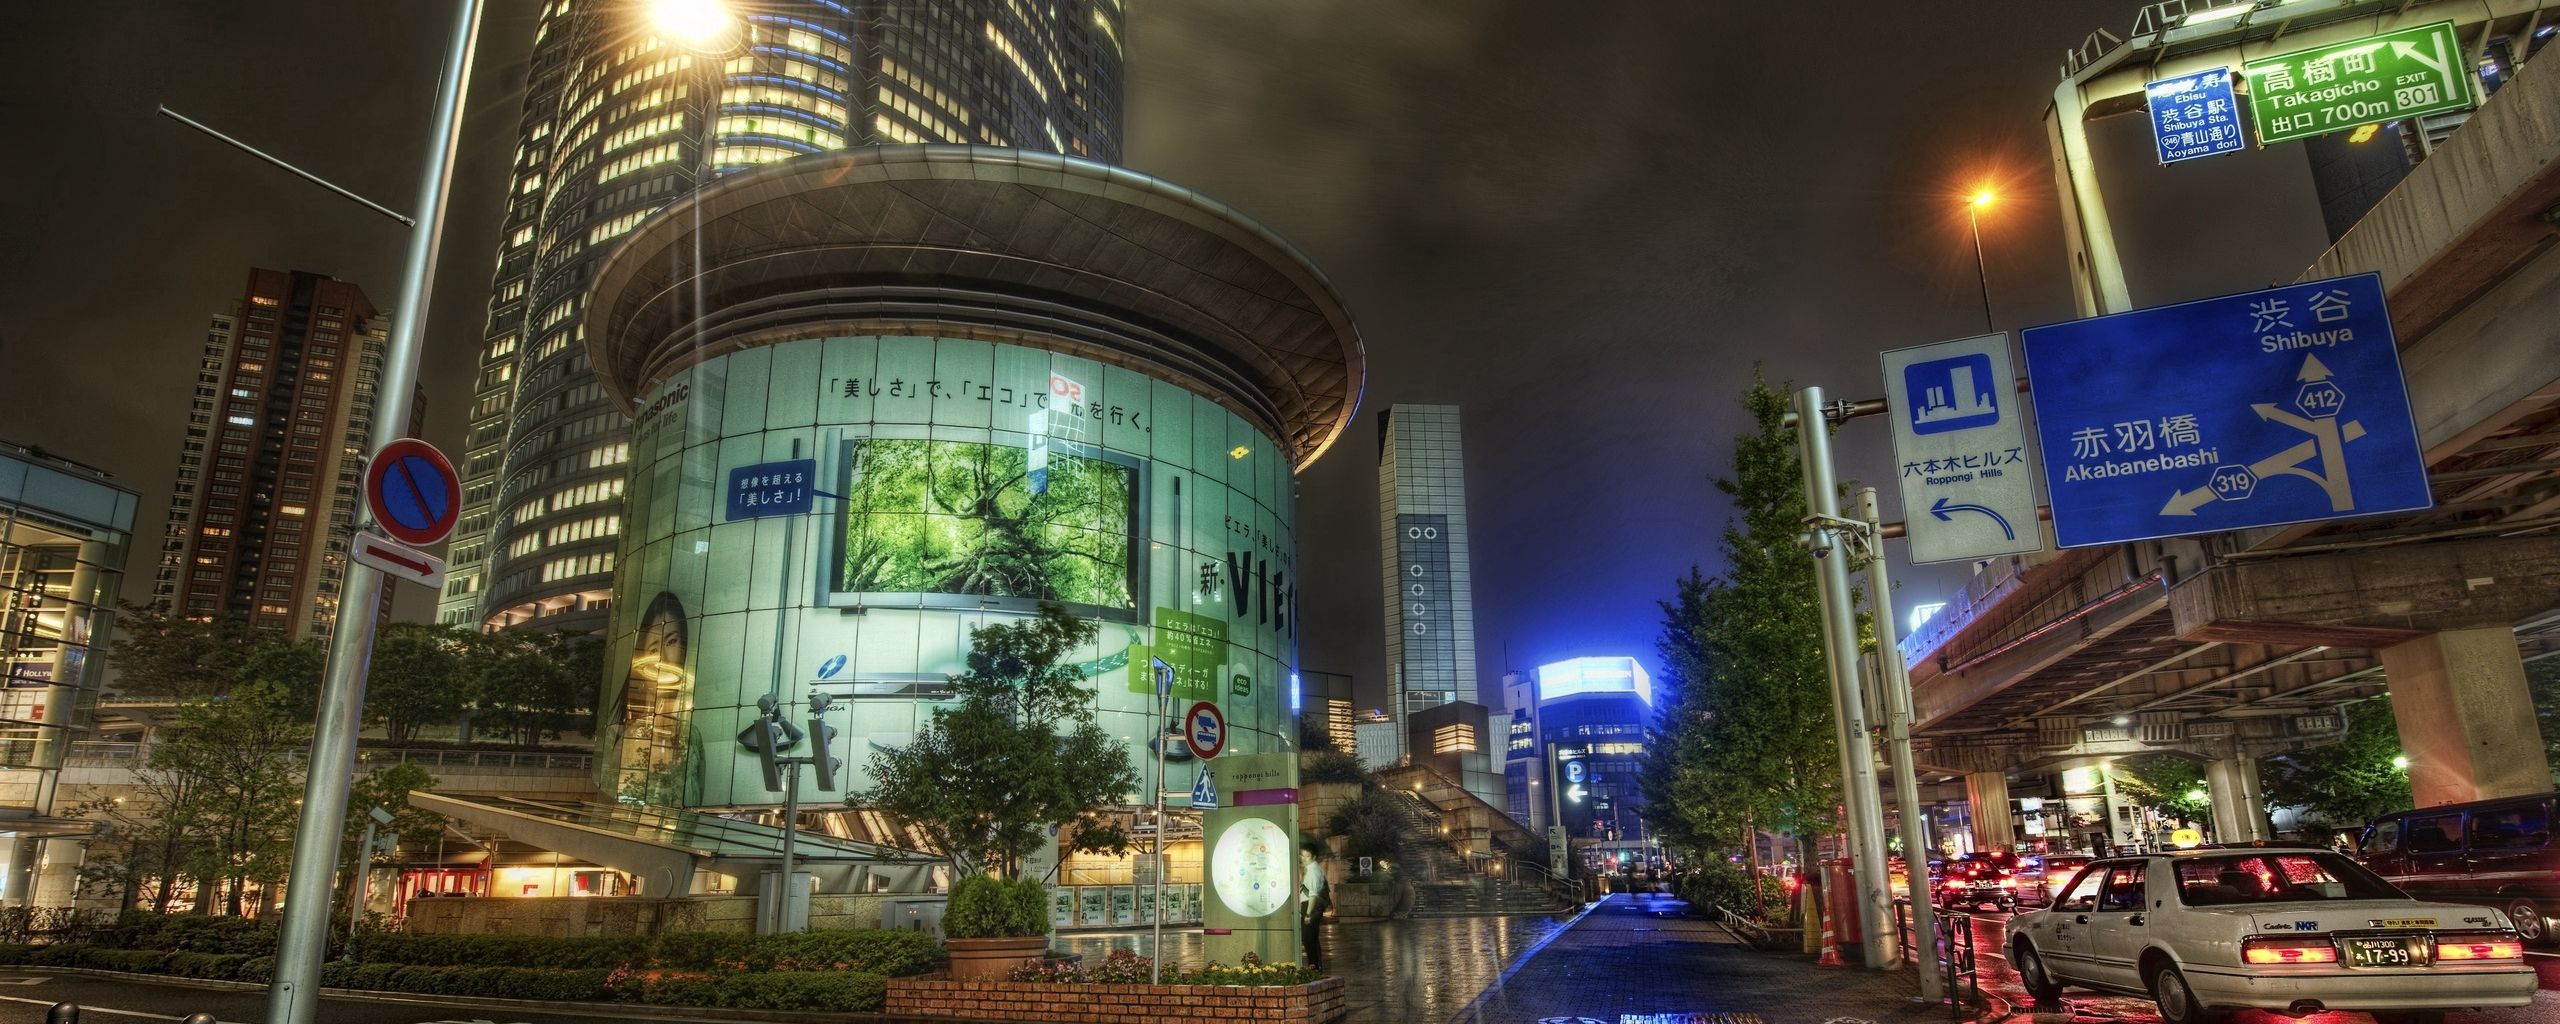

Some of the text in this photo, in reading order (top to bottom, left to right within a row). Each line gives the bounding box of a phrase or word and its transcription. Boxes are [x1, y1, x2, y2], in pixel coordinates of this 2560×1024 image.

[2263, 48, 2377, 95] 高樹町
[2396, 71, 2428, 86] EXIT
[2174, 92, 2206, 103] Ebisu
[2267, 79, 2381, 110] Takagicho
[2397, 85, 2438, 107] 301
[2161, 99, 2228, 124] 渋谷駅
[2271, 100, 2390, 135] 出口 700m
[2163, 114, 2229, 132] Shibuya Sta.
[2164, 124, 2236, 146] 246 青山通り
[2167, 138, 2237, 159] Aoyama dori
[2250, 289, 2351, 333] 渋谷
[2260, 328, 2354, 353] Shibuya
[2303, 389, 2339, 409] 412
[2071, 413, 2201, 460] 赤羽橋
[1903, 446, 2023, 478] 六本木ヒルズ
[2064, 447, 2220, 483] Akabanebashi
[1926, 468, 2003, 485] Roppongi Hills
[2216, 472, 2250, 492] 319
[1569, 764, 1582, 780] P
[2366, 949, 2409, 963] 17-99
